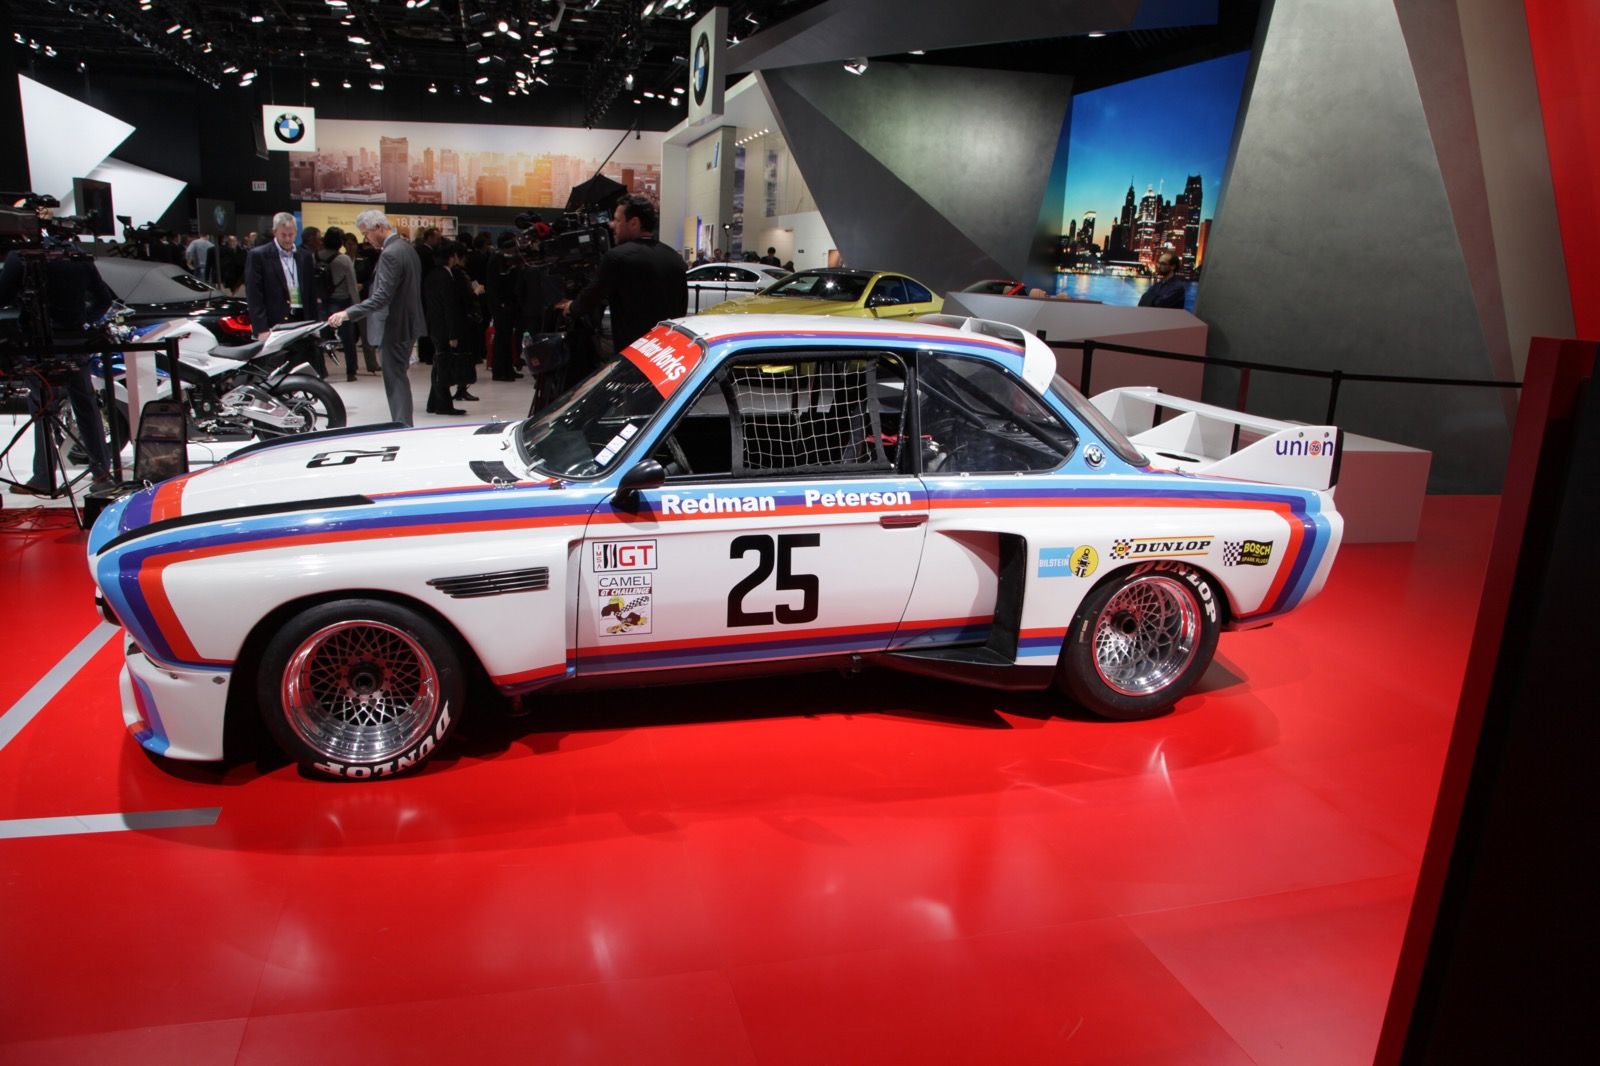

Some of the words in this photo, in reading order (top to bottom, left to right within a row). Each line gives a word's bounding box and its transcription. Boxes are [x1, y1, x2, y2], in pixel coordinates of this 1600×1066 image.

[650, 345, 686, 381] Works
[1275, 440, 1334, 457] union
[661, 494, 776, 516] Redman
[804, 489, 911, 508] Peterson
[618, 544, 654, 567] GT
[1133, 540, 1211, 553] DUNLOP
[1243, 542, 1272, 556] BOSCH
[1039, 558, 1070, 568] BILSTEIN
[599, 575, 650, 588] CAMEL
[727, 533, 820, 627] 25
[611, 587, 650, 596] CHALLENGE
[1125, 560, 1217, 623] DUNLOP
[313, 699, 451, 779] DUNLOP
